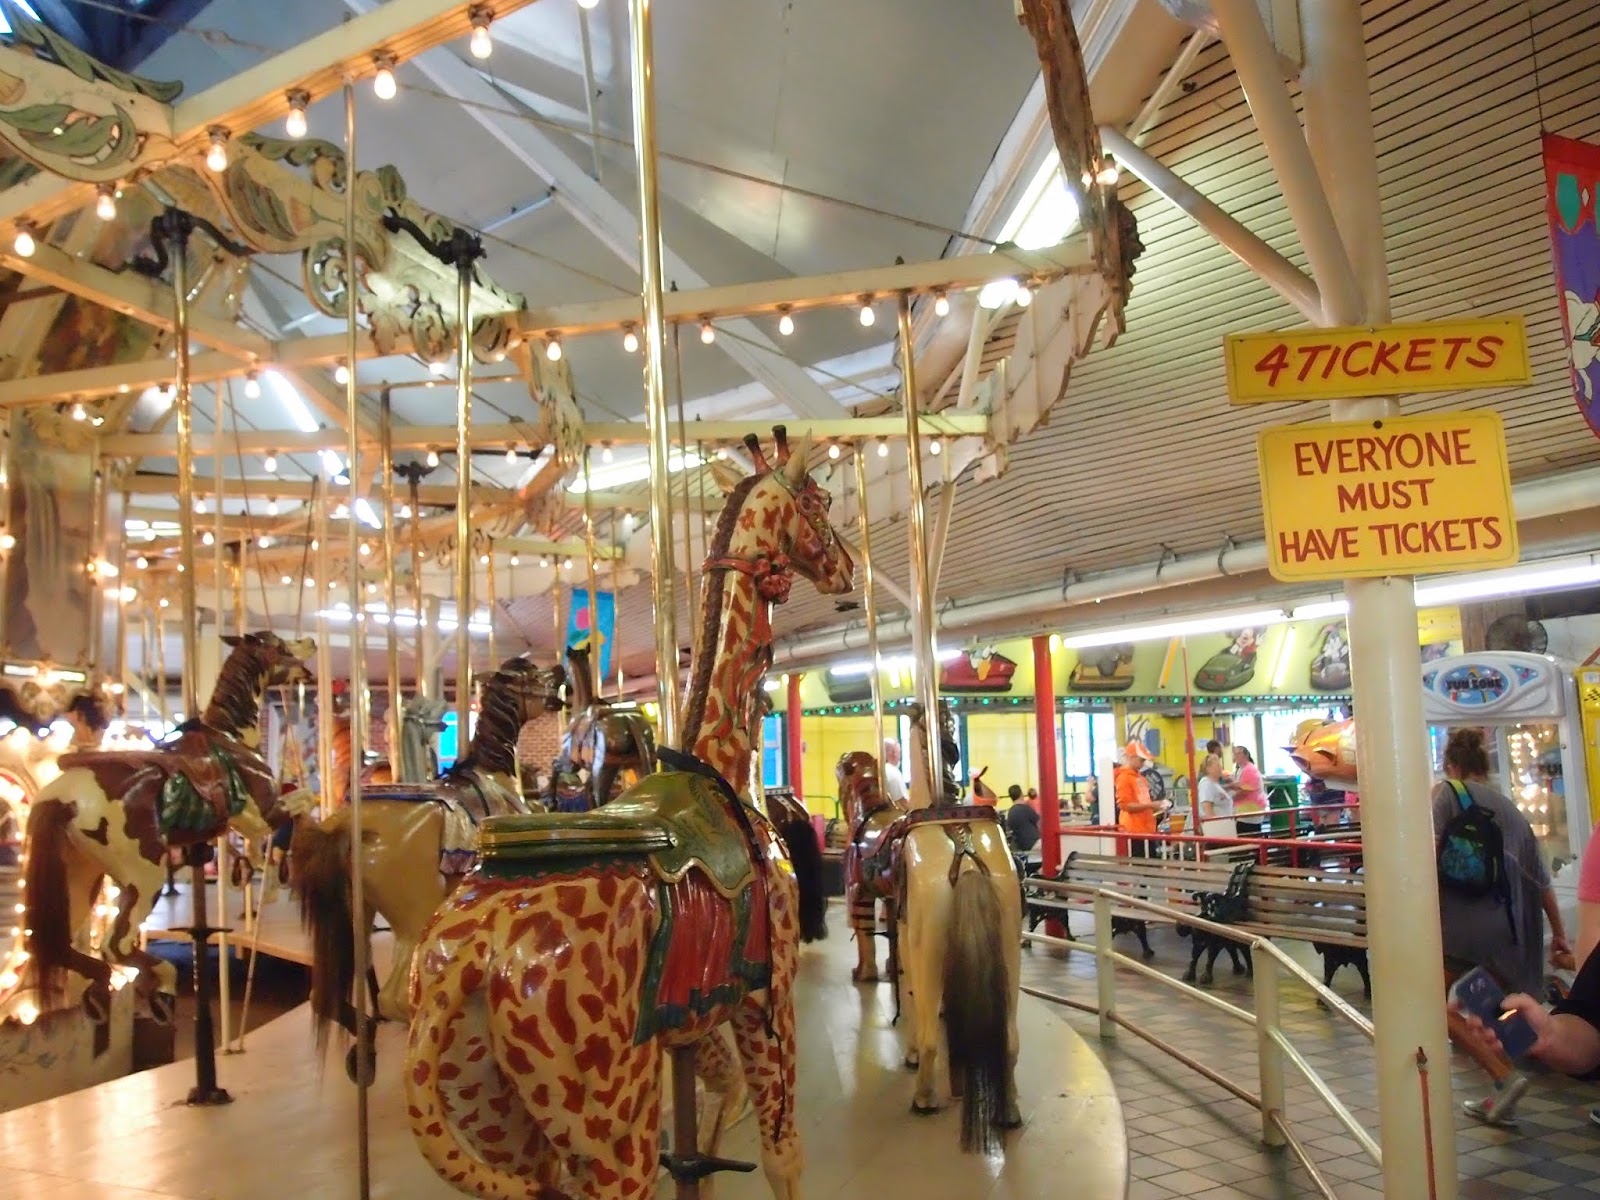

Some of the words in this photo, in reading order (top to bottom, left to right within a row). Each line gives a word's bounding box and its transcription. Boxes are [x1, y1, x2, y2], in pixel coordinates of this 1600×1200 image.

[1254, 343, 1289, 387] 4
[1297, 335, 1504, 382] TICKETS
[1294, 428, 1476, 476] EVERYONE
[1337, 478, 1434, 512] MUST
[1279, 526, 1359, 563] HAVE
[1368, 516, 1502, 556] TICKETS
